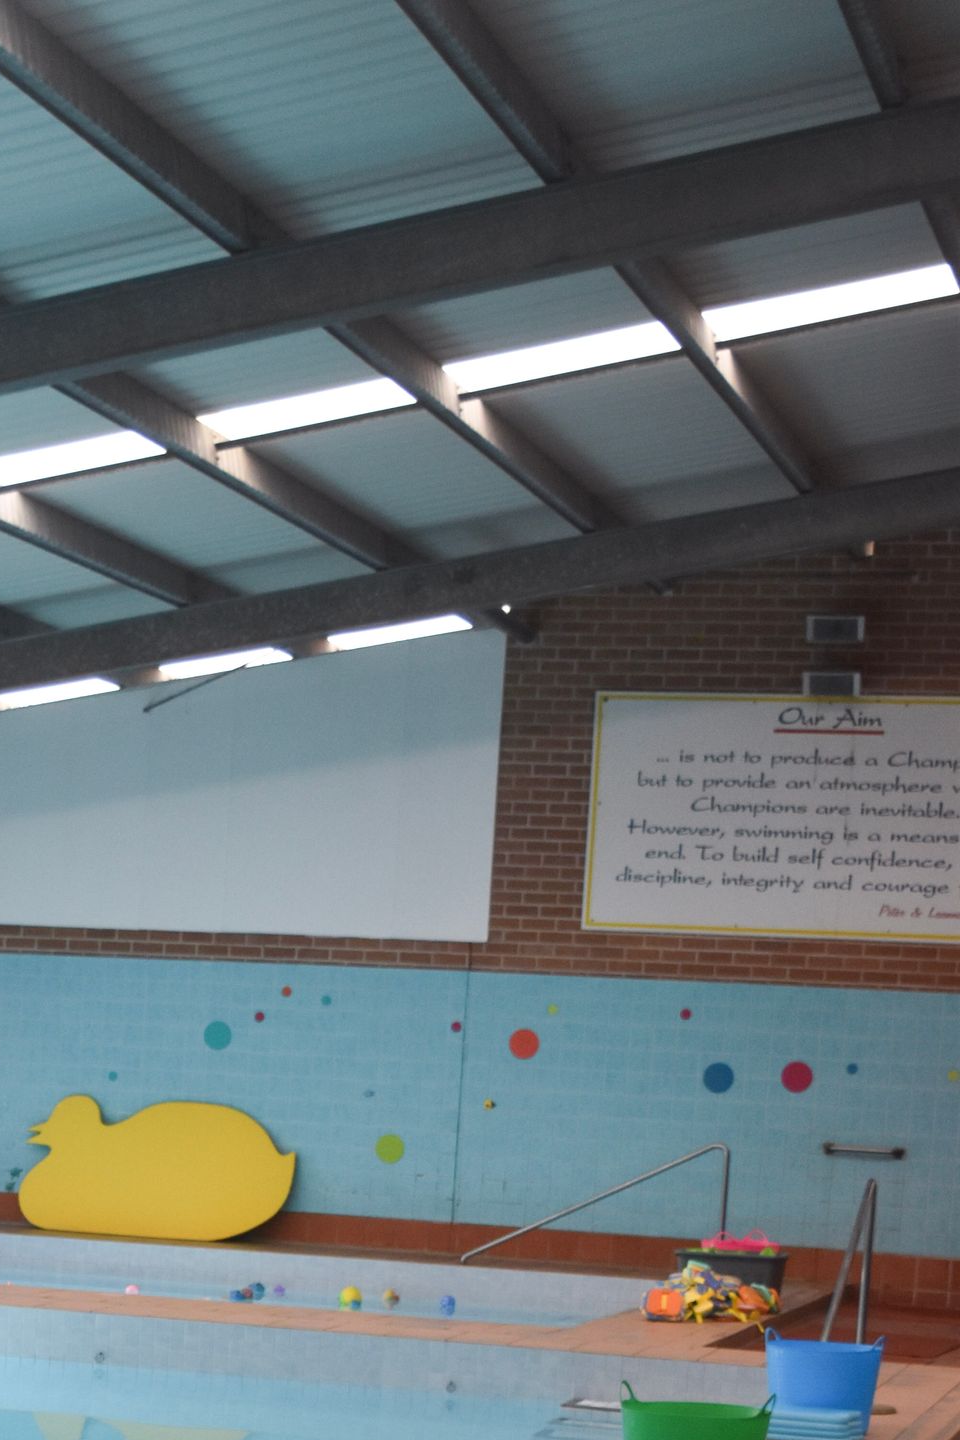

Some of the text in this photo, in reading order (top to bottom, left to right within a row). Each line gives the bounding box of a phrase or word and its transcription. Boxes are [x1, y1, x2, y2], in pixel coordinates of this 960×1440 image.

[778, 706, 883, 729] Our Aim
[679, 749, 695, 763] is
[703, 749, 735, 764] not
[743, 751, 762, 764] to
[770, 748, 855, 768] produce
[865, 758, 878, 767] a
[637, 771, 667, 788] but
[675, 774, 693, 788] to
[701, 772, 776, 792] provide
[785, 779, 811, 790] an
[819, 775, 942, 796] atmosphere
[690, 796, 960, 819] Champions are inevitable.
[627, 818, 960, 846] However, swimming is a means
[645, 843, 952, 872] end. To build self confidence,
[615, 865, 949, 899] discipline, integrity and courage
